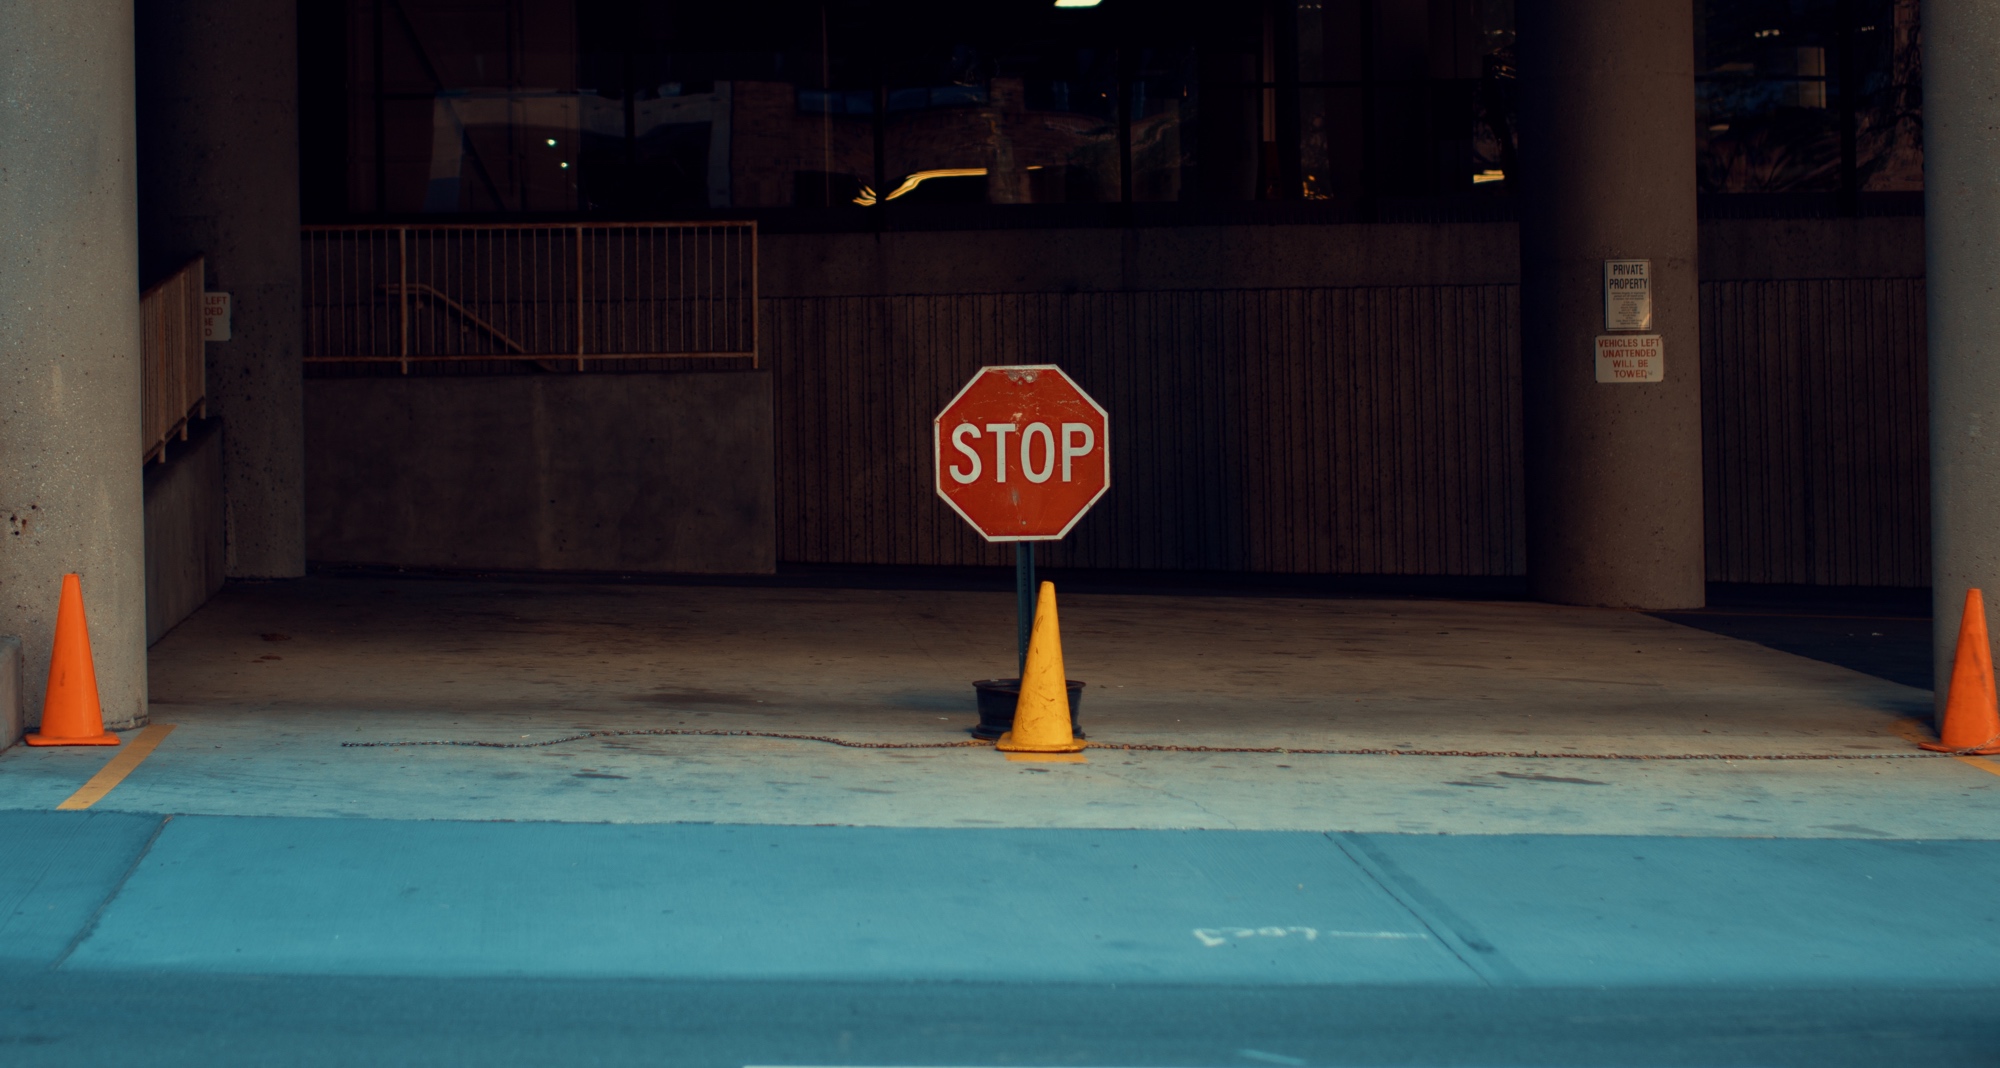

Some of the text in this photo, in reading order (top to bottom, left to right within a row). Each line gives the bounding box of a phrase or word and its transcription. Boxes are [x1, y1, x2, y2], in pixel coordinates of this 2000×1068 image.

[1613, 264, 1643, 275] PRIVATE
[1609, 278, 1647, 289] PROPERTY
[205, 296, 227, 305] LEFT
[1598, 338, 1660, 348] VEHICLES LEFT
[1602, 349, 1657, 358] UNATTENDED
[1612, 359, 1649, 368] WILL BE
[1614, 369, 1647, 379] TOWED
[949, 422, 1095, 484] STOP
